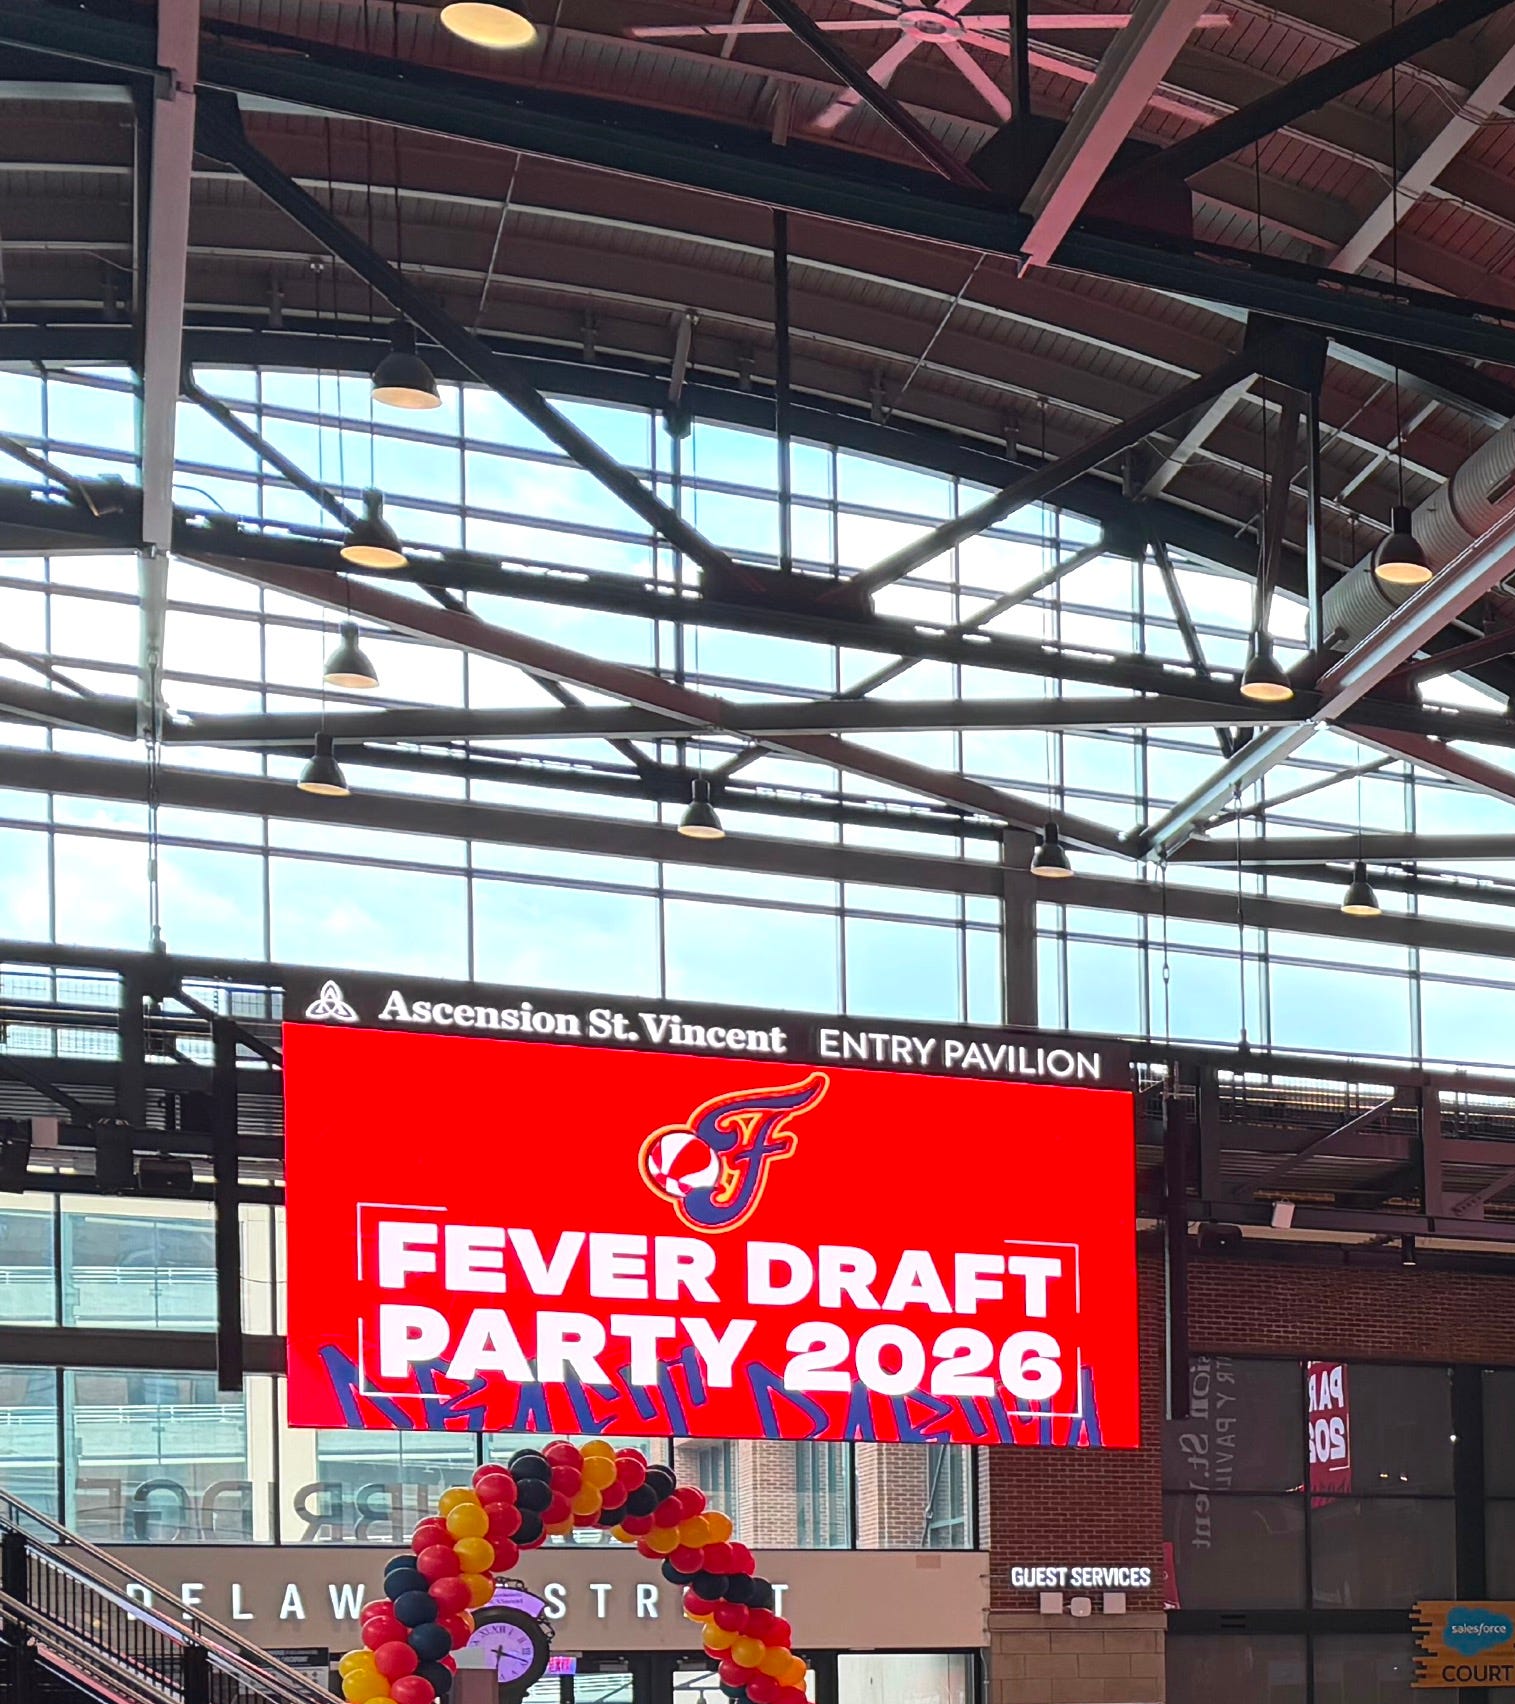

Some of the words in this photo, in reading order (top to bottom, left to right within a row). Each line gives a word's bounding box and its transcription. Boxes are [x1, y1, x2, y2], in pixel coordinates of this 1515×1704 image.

[378, 990, 581, 1036] Ascension
[587, 1007, 641, 1041] St.
[639, 1012, 788, 1054] Vincent
[819, 1028, 937, 1066] ENTRY
[944, 1039, 1101, 1080] PAVILION
[378, 1219, 721, 1304] FEVER
[746, 1240, 1063, 1318] DRAFT
[379, 1303, 757, 1388] PARTY
[783, 1319, 1063, 1401] 2026
[1011, 1566, 1068, 1587] GUEST
[1069, 1566, 1152, 1588] SERVICES
[543, 1583, 789, 1620] STRT
[1451, 1622, 1507, 1636] salesforce
[1442, 1664, 1514, 1682] COURT
